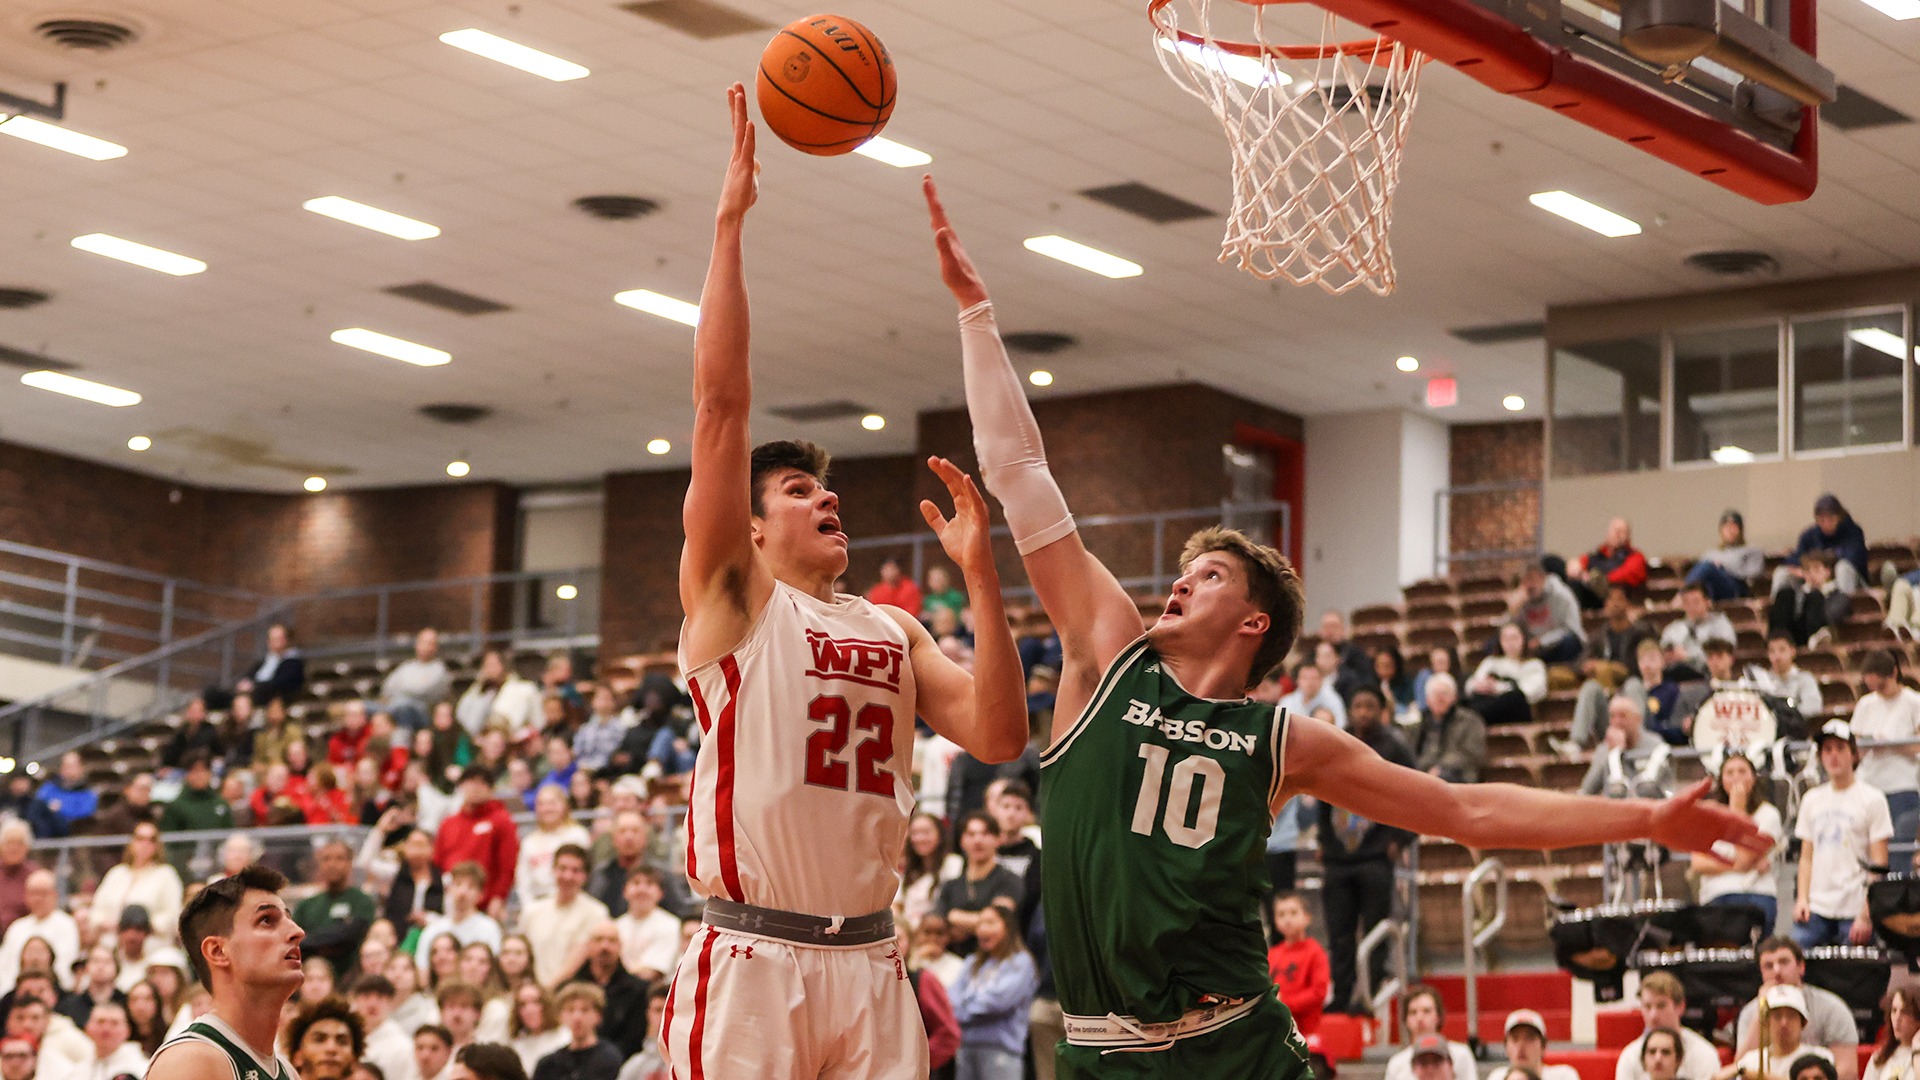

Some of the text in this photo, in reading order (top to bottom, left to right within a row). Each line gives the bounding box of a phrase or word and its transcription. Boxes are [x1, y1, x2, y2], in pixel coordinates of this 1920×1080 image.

[805, 635, 903, 685] WPI
[1121, 699, 1257, 756] BABSON
[1714, 702, 1760, 720] WPI
[804, 693, 896, 799] 22
[1131, 742, 1226, 849] 10
